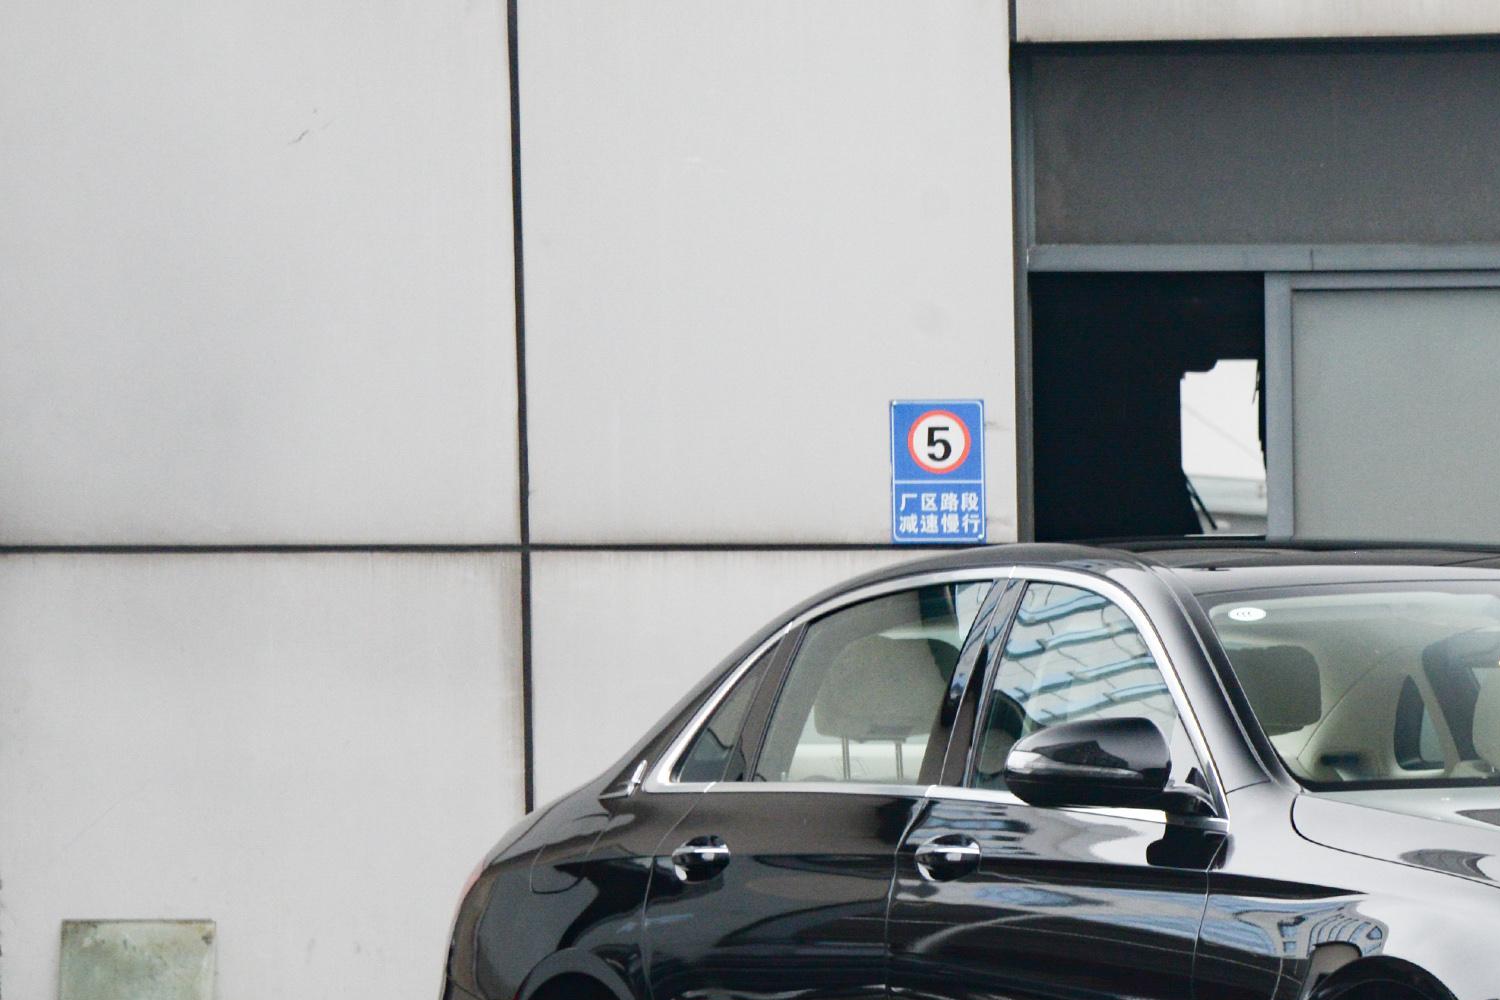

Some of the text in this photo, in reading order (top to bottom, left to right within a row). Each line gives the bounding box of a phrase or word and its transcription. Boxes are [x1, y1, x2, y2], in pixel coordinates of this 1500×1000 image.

[927, 426, 952, 462] 5
[900, 492, 979, 511] 厂区路段
[899, 513, 981, 533] 减速慢行
